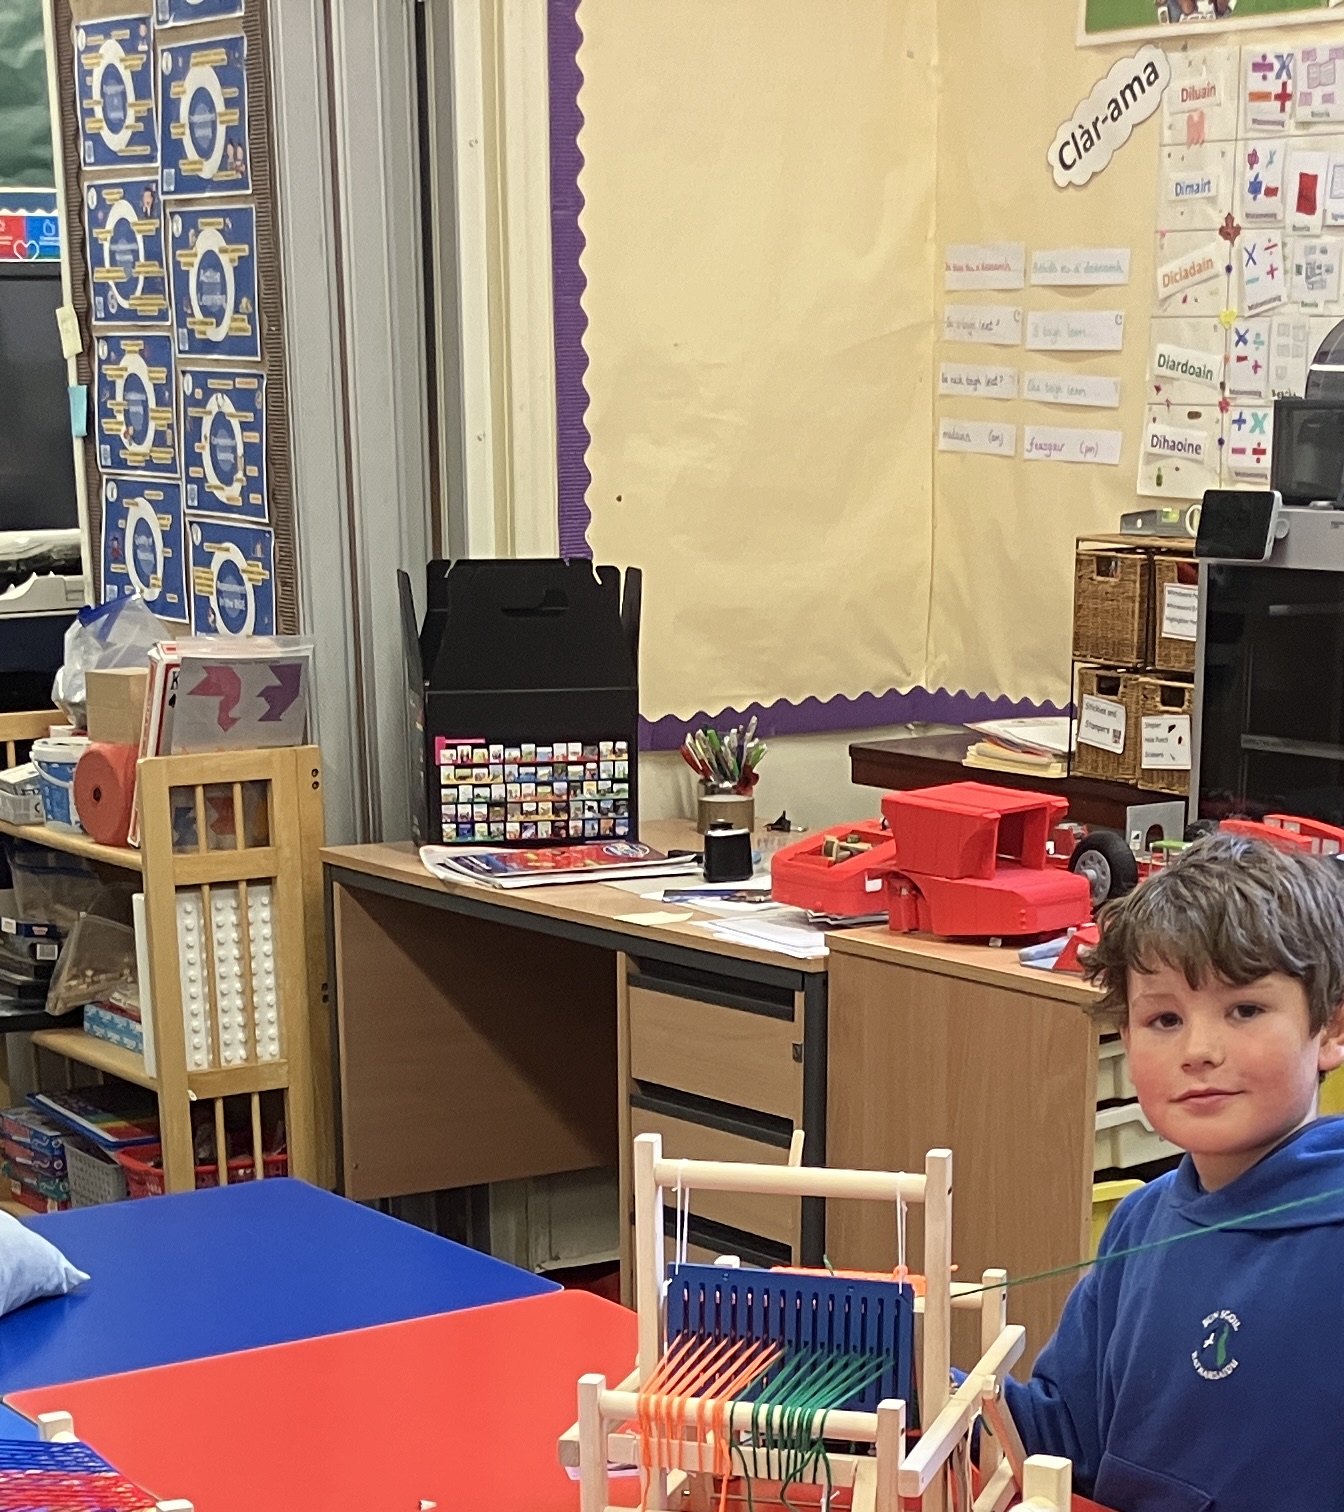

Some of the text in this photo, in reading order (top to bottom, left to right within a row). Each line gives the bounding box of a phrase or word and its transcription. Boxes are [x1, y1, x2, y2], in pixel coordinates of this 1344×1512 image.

[1180, 82, 1217, 103] Diluain
[1058, 61, 1160, 172] Clàr-ama
[1150, 433, 1202, 456] Dihaoine
